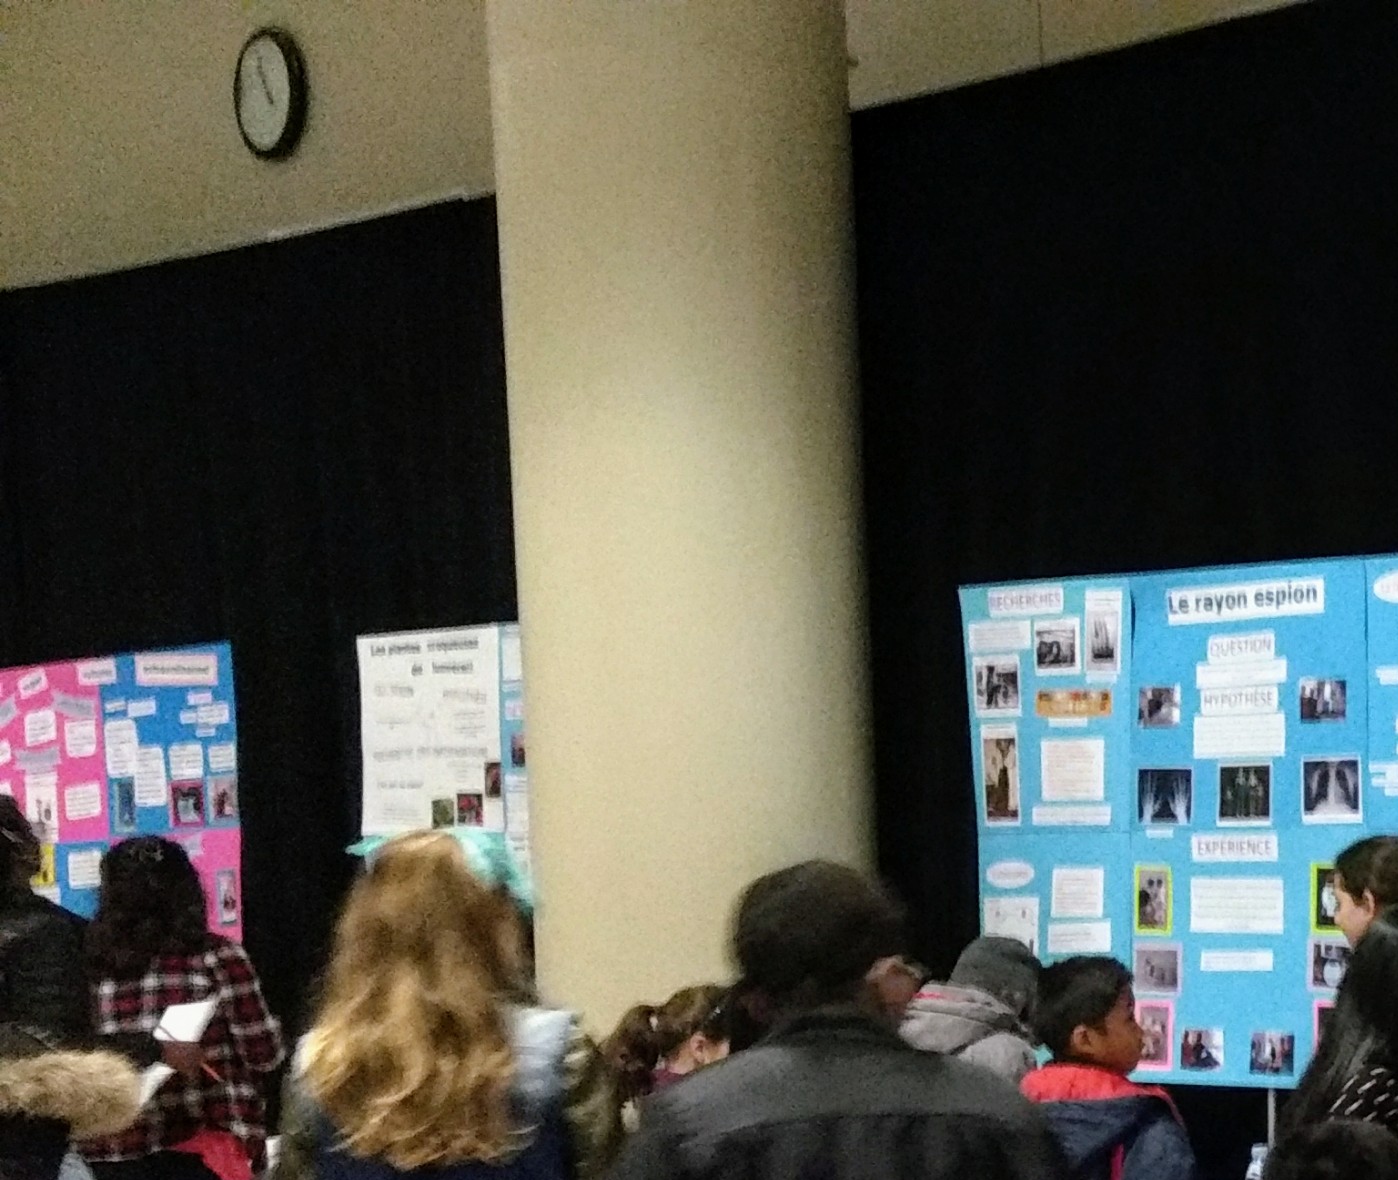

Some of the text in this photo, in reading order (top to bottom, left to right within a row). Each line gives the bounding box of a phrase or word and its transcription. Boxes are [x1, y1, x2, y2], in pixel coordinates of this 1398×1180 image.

[1168, 584, 1318, 617] Le rayon espion
